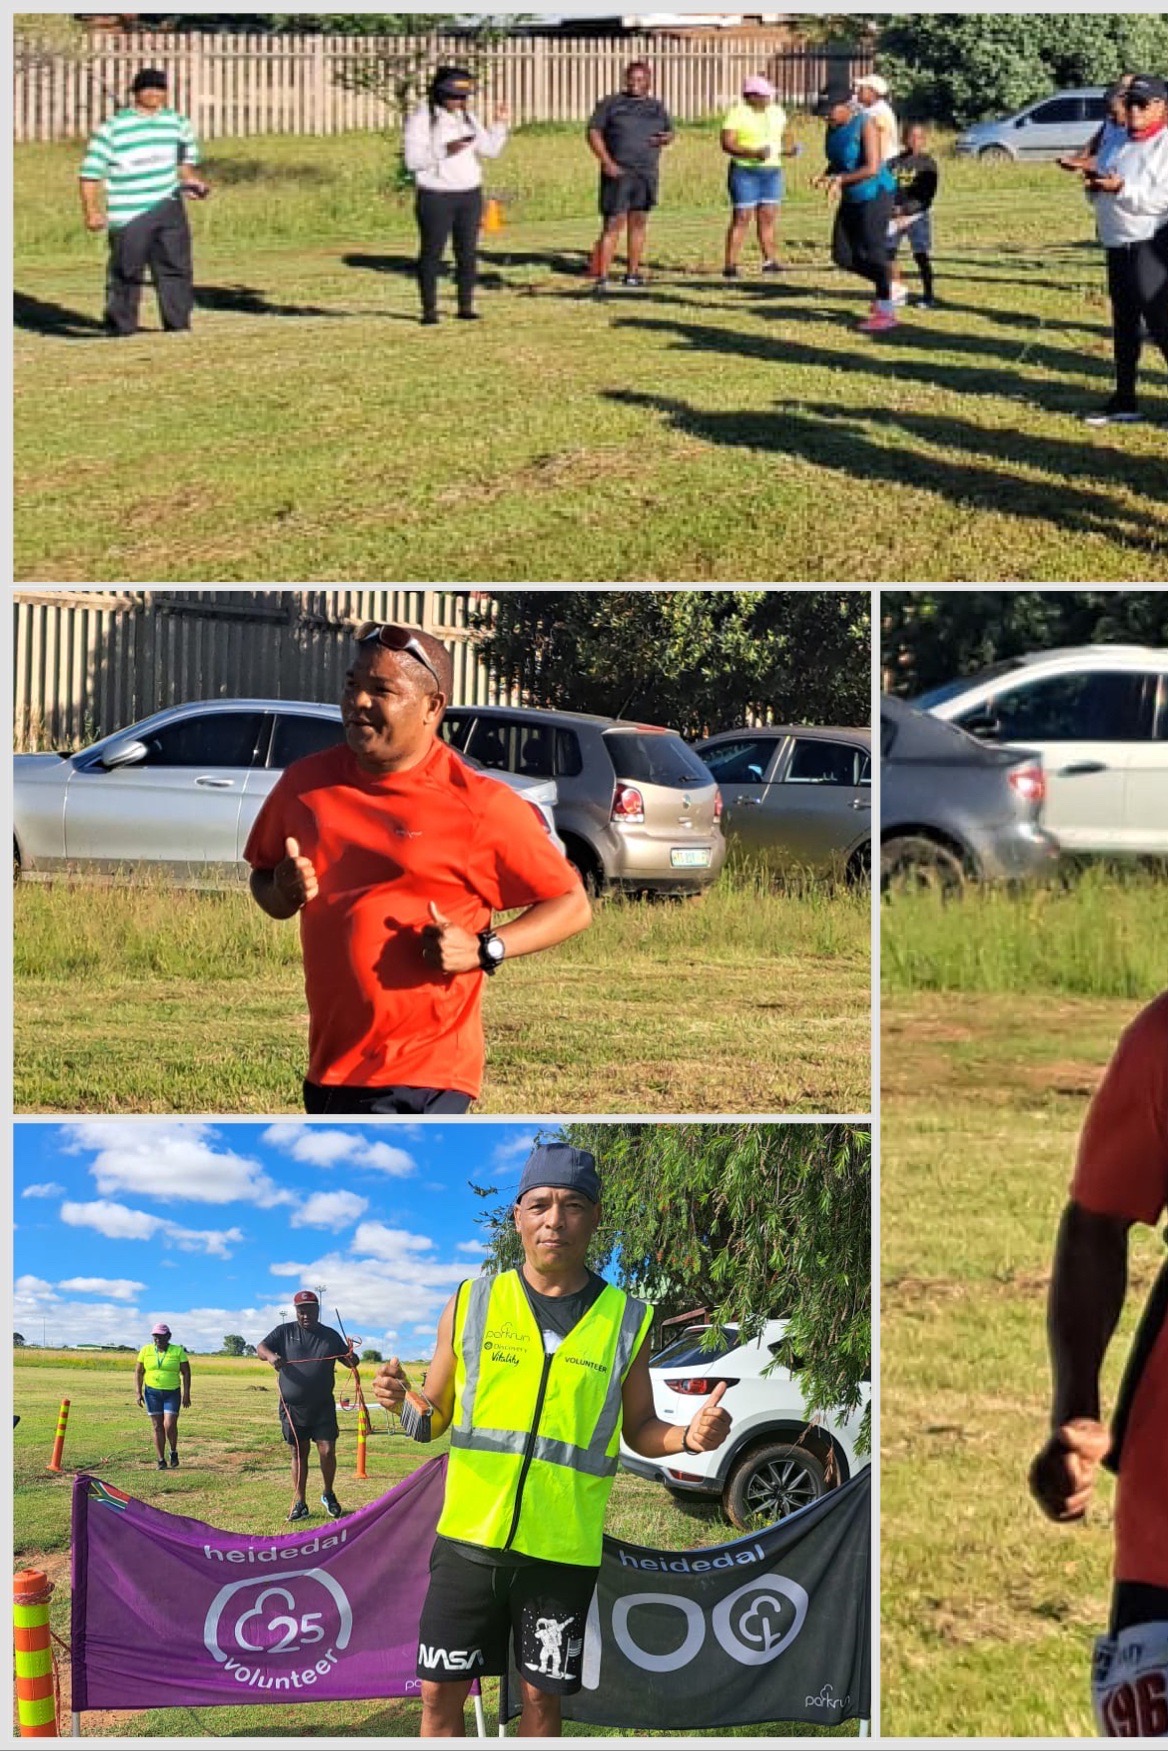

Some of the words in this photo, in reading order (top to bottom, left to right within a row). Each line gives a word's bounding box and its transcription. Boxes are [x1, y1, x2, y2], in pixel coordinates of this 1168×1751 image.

[491, 1352, 519, 1367] Vitality
[564, 1356, 608, 1373] VOLUNTEER
[203, 1529, 347, 1563] heidedal
[618, 1543, 766, 1573] heidedal
[267, 1612, 325, 1653] 25
[224, 1648, 338, 1689] volunteer
[418, 1643, 484, 1670] NASA
